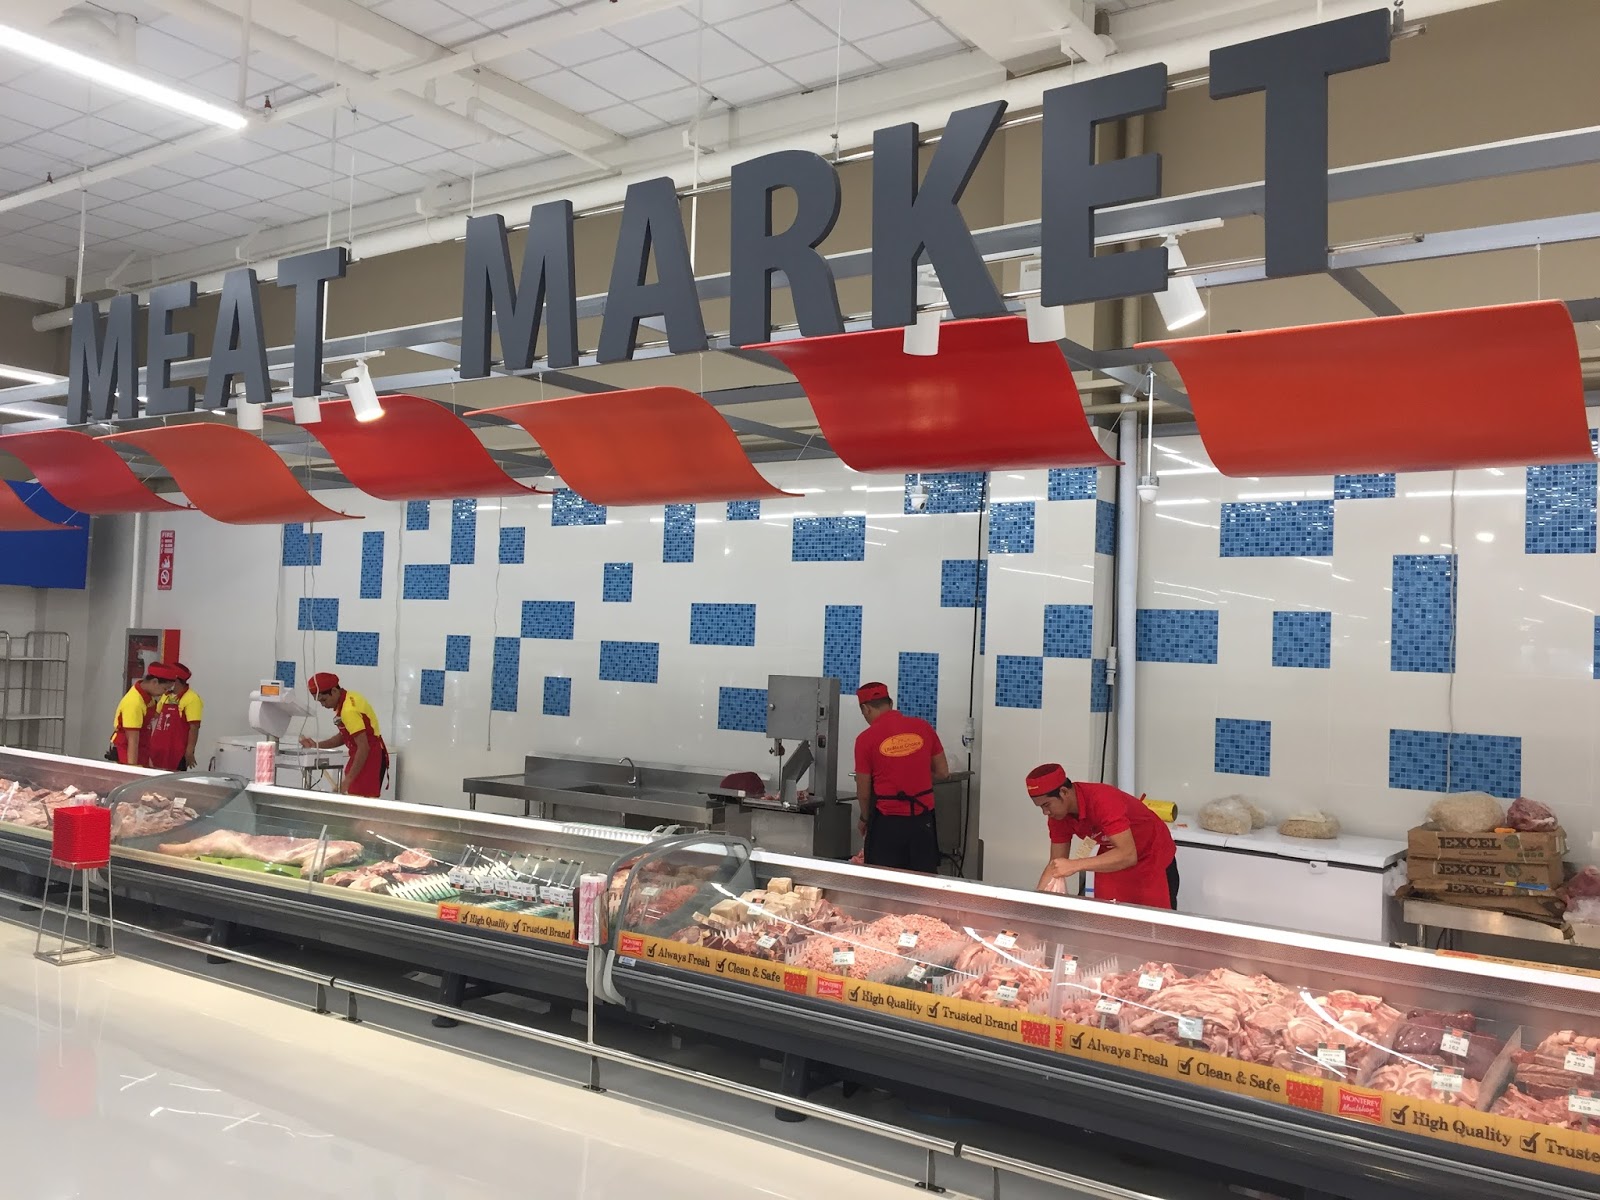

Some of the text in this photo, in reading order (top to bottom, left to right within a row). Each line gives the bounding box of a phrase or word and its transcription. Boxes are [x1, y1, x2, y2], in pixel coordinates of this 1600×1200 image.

[67, 8, 1391, 424] MEAT MARKET
[1438, 837, 1501, 850] EXCEL
[1438, 863, 1500, 877] EXCEL
[1445, 883, 1508, 896] EXCEL
[469, 914, 571, 939] High Quality Trusted Brand
[658, 947, 781, 982] Always Fresh Clean & Safe
[861, 990, 1018, 1032] High Quality Trusted Brand
[1087, 1037, 1281, 1093] Always Fresh Clean & Safe
[1341, 1094, 1379, 1107] MONTEREY
[1412, 1110, 1448, 1132] High
[1452, 1119, 1512, 1147] Quality
